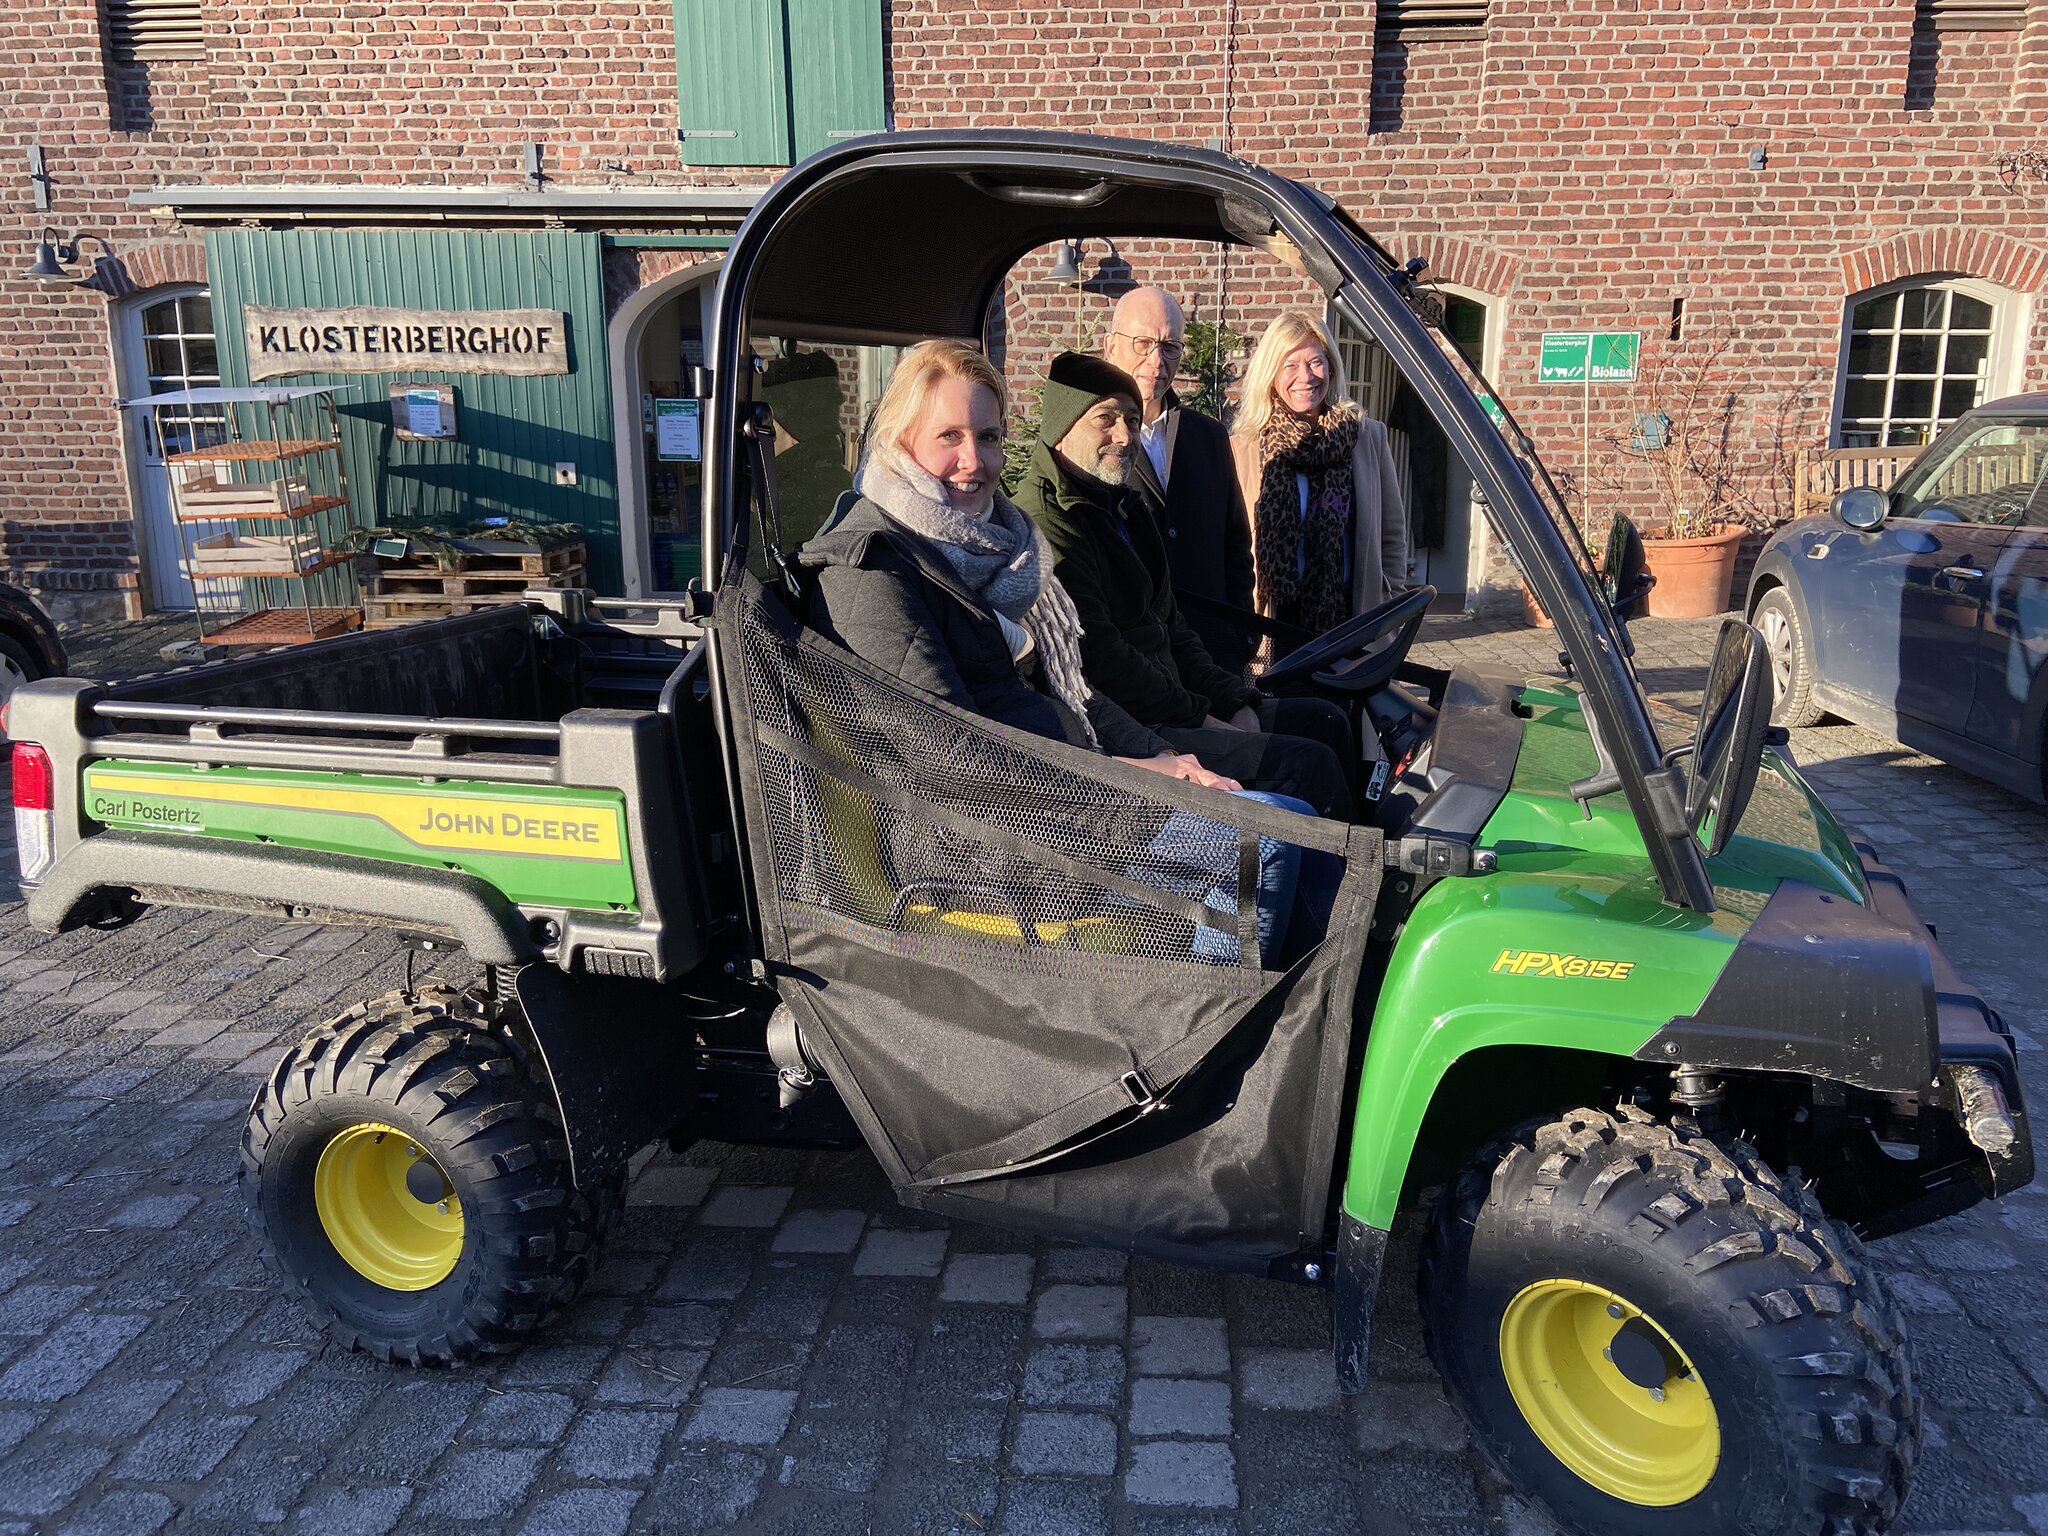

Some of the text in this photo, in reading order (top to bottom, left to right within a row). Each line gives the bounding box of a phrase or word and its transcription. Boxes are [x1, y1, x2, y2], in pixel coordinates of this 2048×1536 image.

[260, 325, 553, 354] KLOSTERBERGHOF
[272, 635, 298, 644] WEST
[94, 797, 201, 825] Carl Postertz
[419, 807, 600, 843] JOHN DEERE
[1489, 949, 1637, 981] HPX815E
